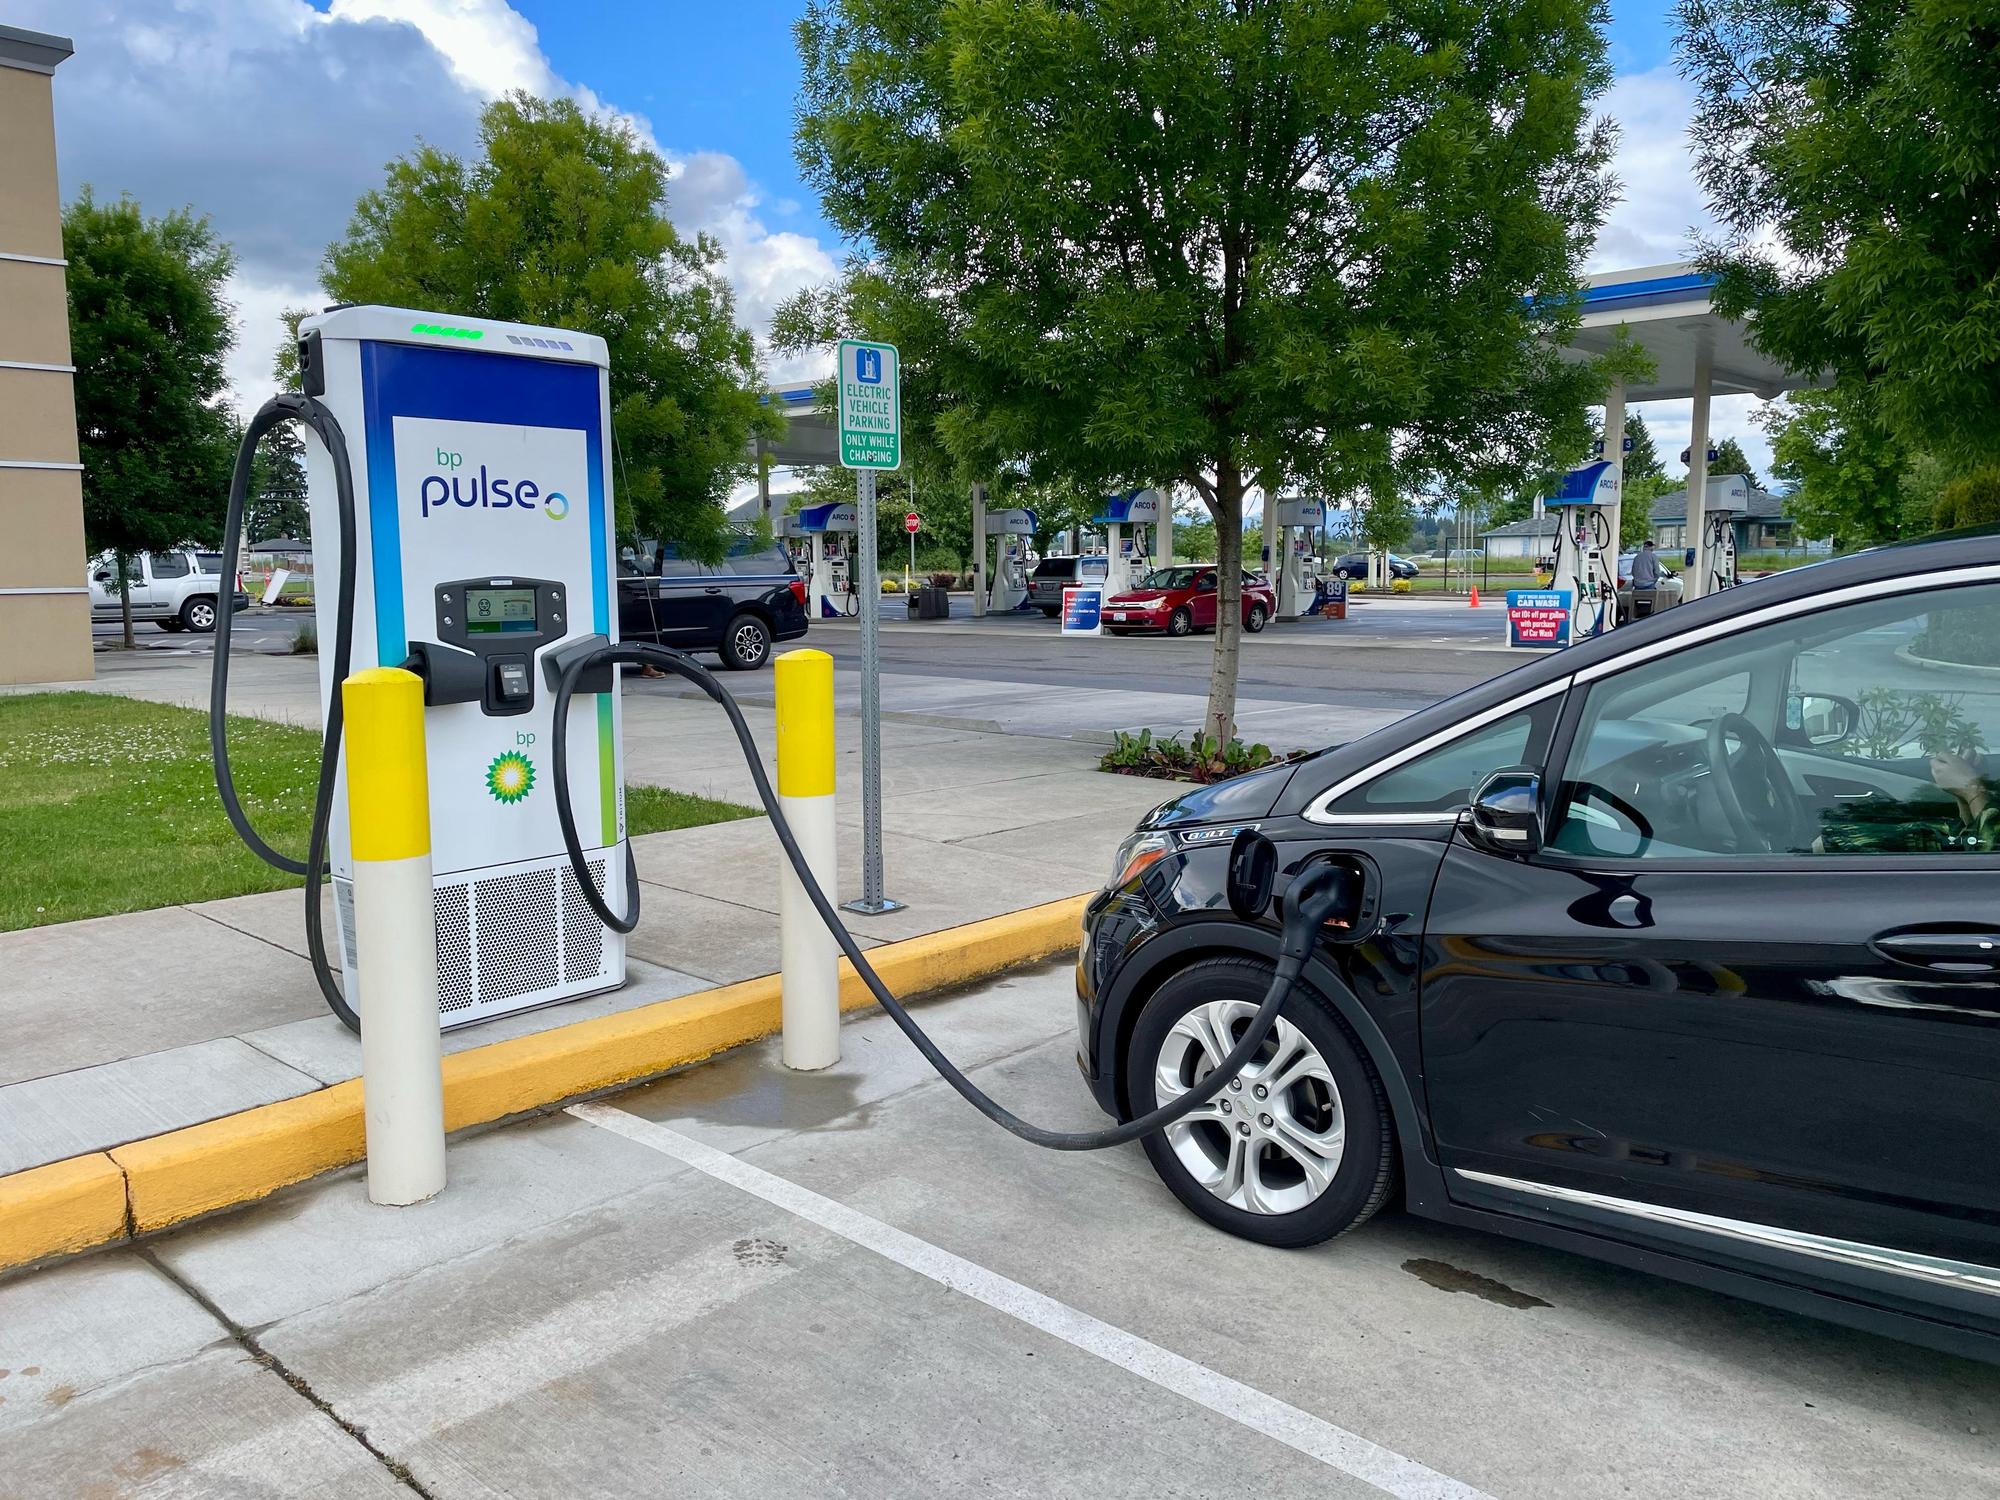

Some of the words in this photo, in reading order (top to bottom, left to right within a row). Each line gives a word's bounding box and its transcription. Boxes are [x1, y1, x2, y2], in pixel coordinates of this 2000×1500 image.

[847, 384, 891, 400] ELECTRIC
[850, 400, 888, 414] VEHICLE
[849, 415, 890, 429] PARKING
[846, 434, 866, 446] ONLY
[869, 436, 894, 448] WHILE
[437, 447, 462, 470] bp
[849, 449, 891, 462] CHARGING
[421, 465, 539, 517] pulse
[1600, 479, 1613, 489] ARCO
[1134, 501, 1151, 509] ARCO
[1326, 581, 1342, 595] 89
[1511, 610, 1521, 618] Get
[1540, 612, 1548, 620] per
[1549, 611, 1566, 620] gallon
[1520, 620, 1531, 628] with
[1532, 620, 1556, 629] purchase
[1522, 629, 1528, 637] of
[1529, 629, 1538, 637] Car
[1539, 629, 1553, 637] Wash
[516, 731, 536, 747] bp
[1187, 829, 1228, 840] BOLT
